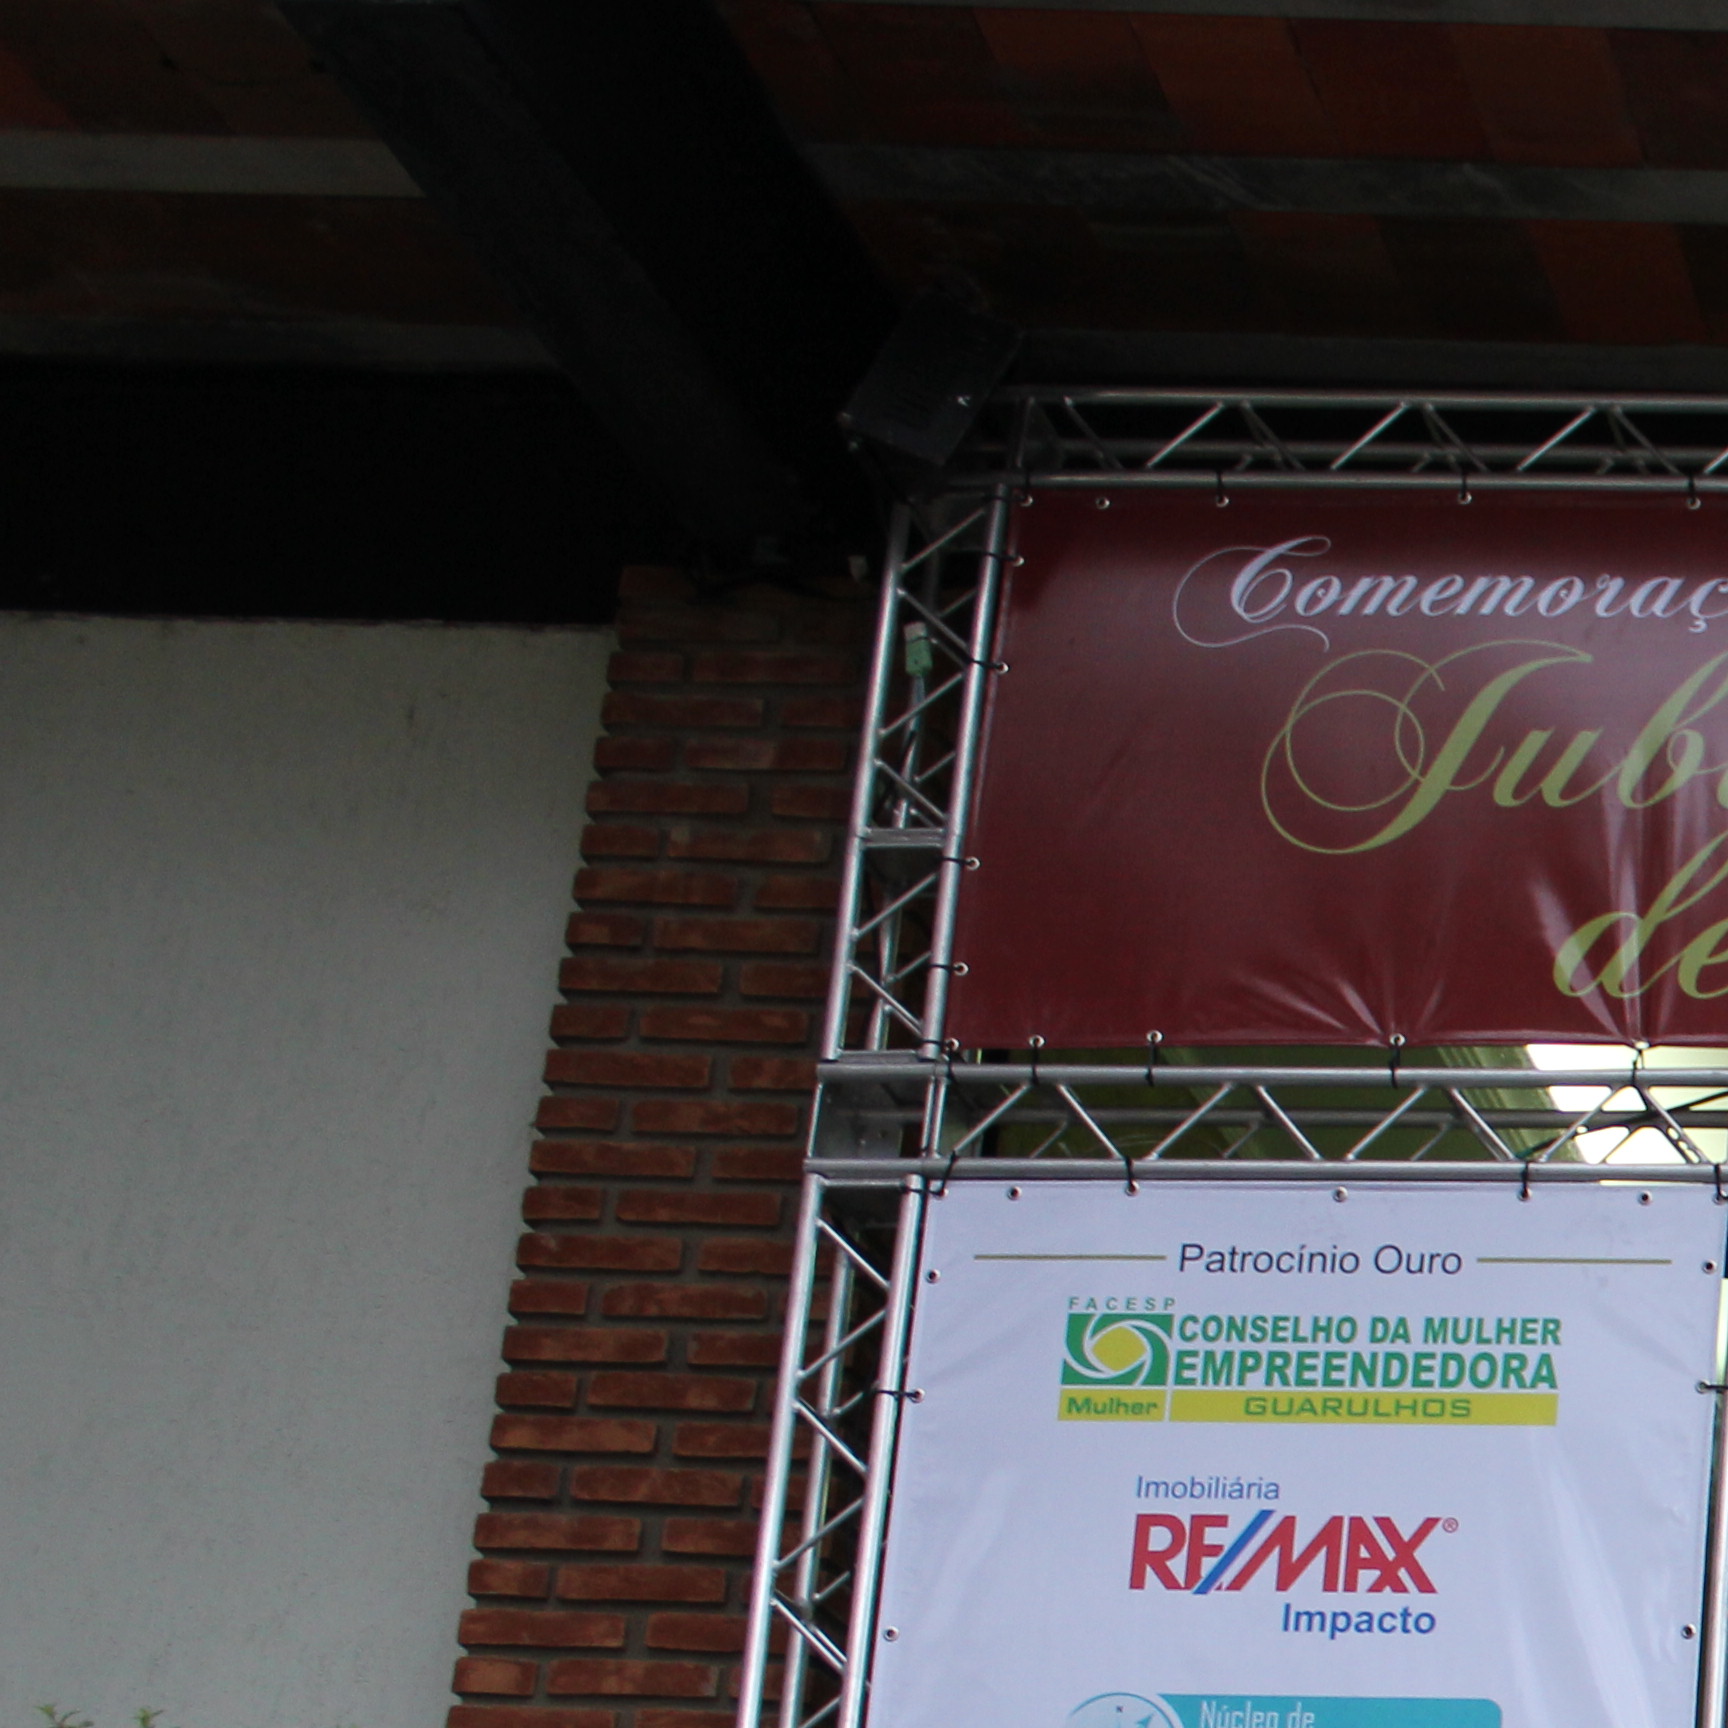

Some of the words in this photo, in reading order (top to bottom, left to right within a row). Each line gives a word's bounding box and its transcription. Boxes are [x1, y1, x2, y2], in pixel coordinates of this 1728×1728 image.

[1178, 1244, 1360, 1275] Patrocínio
[1373, 1245, 1463, 1276] Ouro
[1068, 1296, 1176, 1312] FACESP
[1178, 1315, 1359, 1345] CONSELHO
[1369, 1316, 1412, 1345] DA
[1422, 1317, 1562, 1347] MULHER
[1174, 1351, 1559, 1390] EMPREENDEDORA
[1066, 1396, 1158, 1417] Mulher
[1243, 1396, 1472, 1419] GUARULHOS
[1135, 1475, 1281, 1501] Imobiliária
[1281, 1603, 1437, 1640] Impacto
